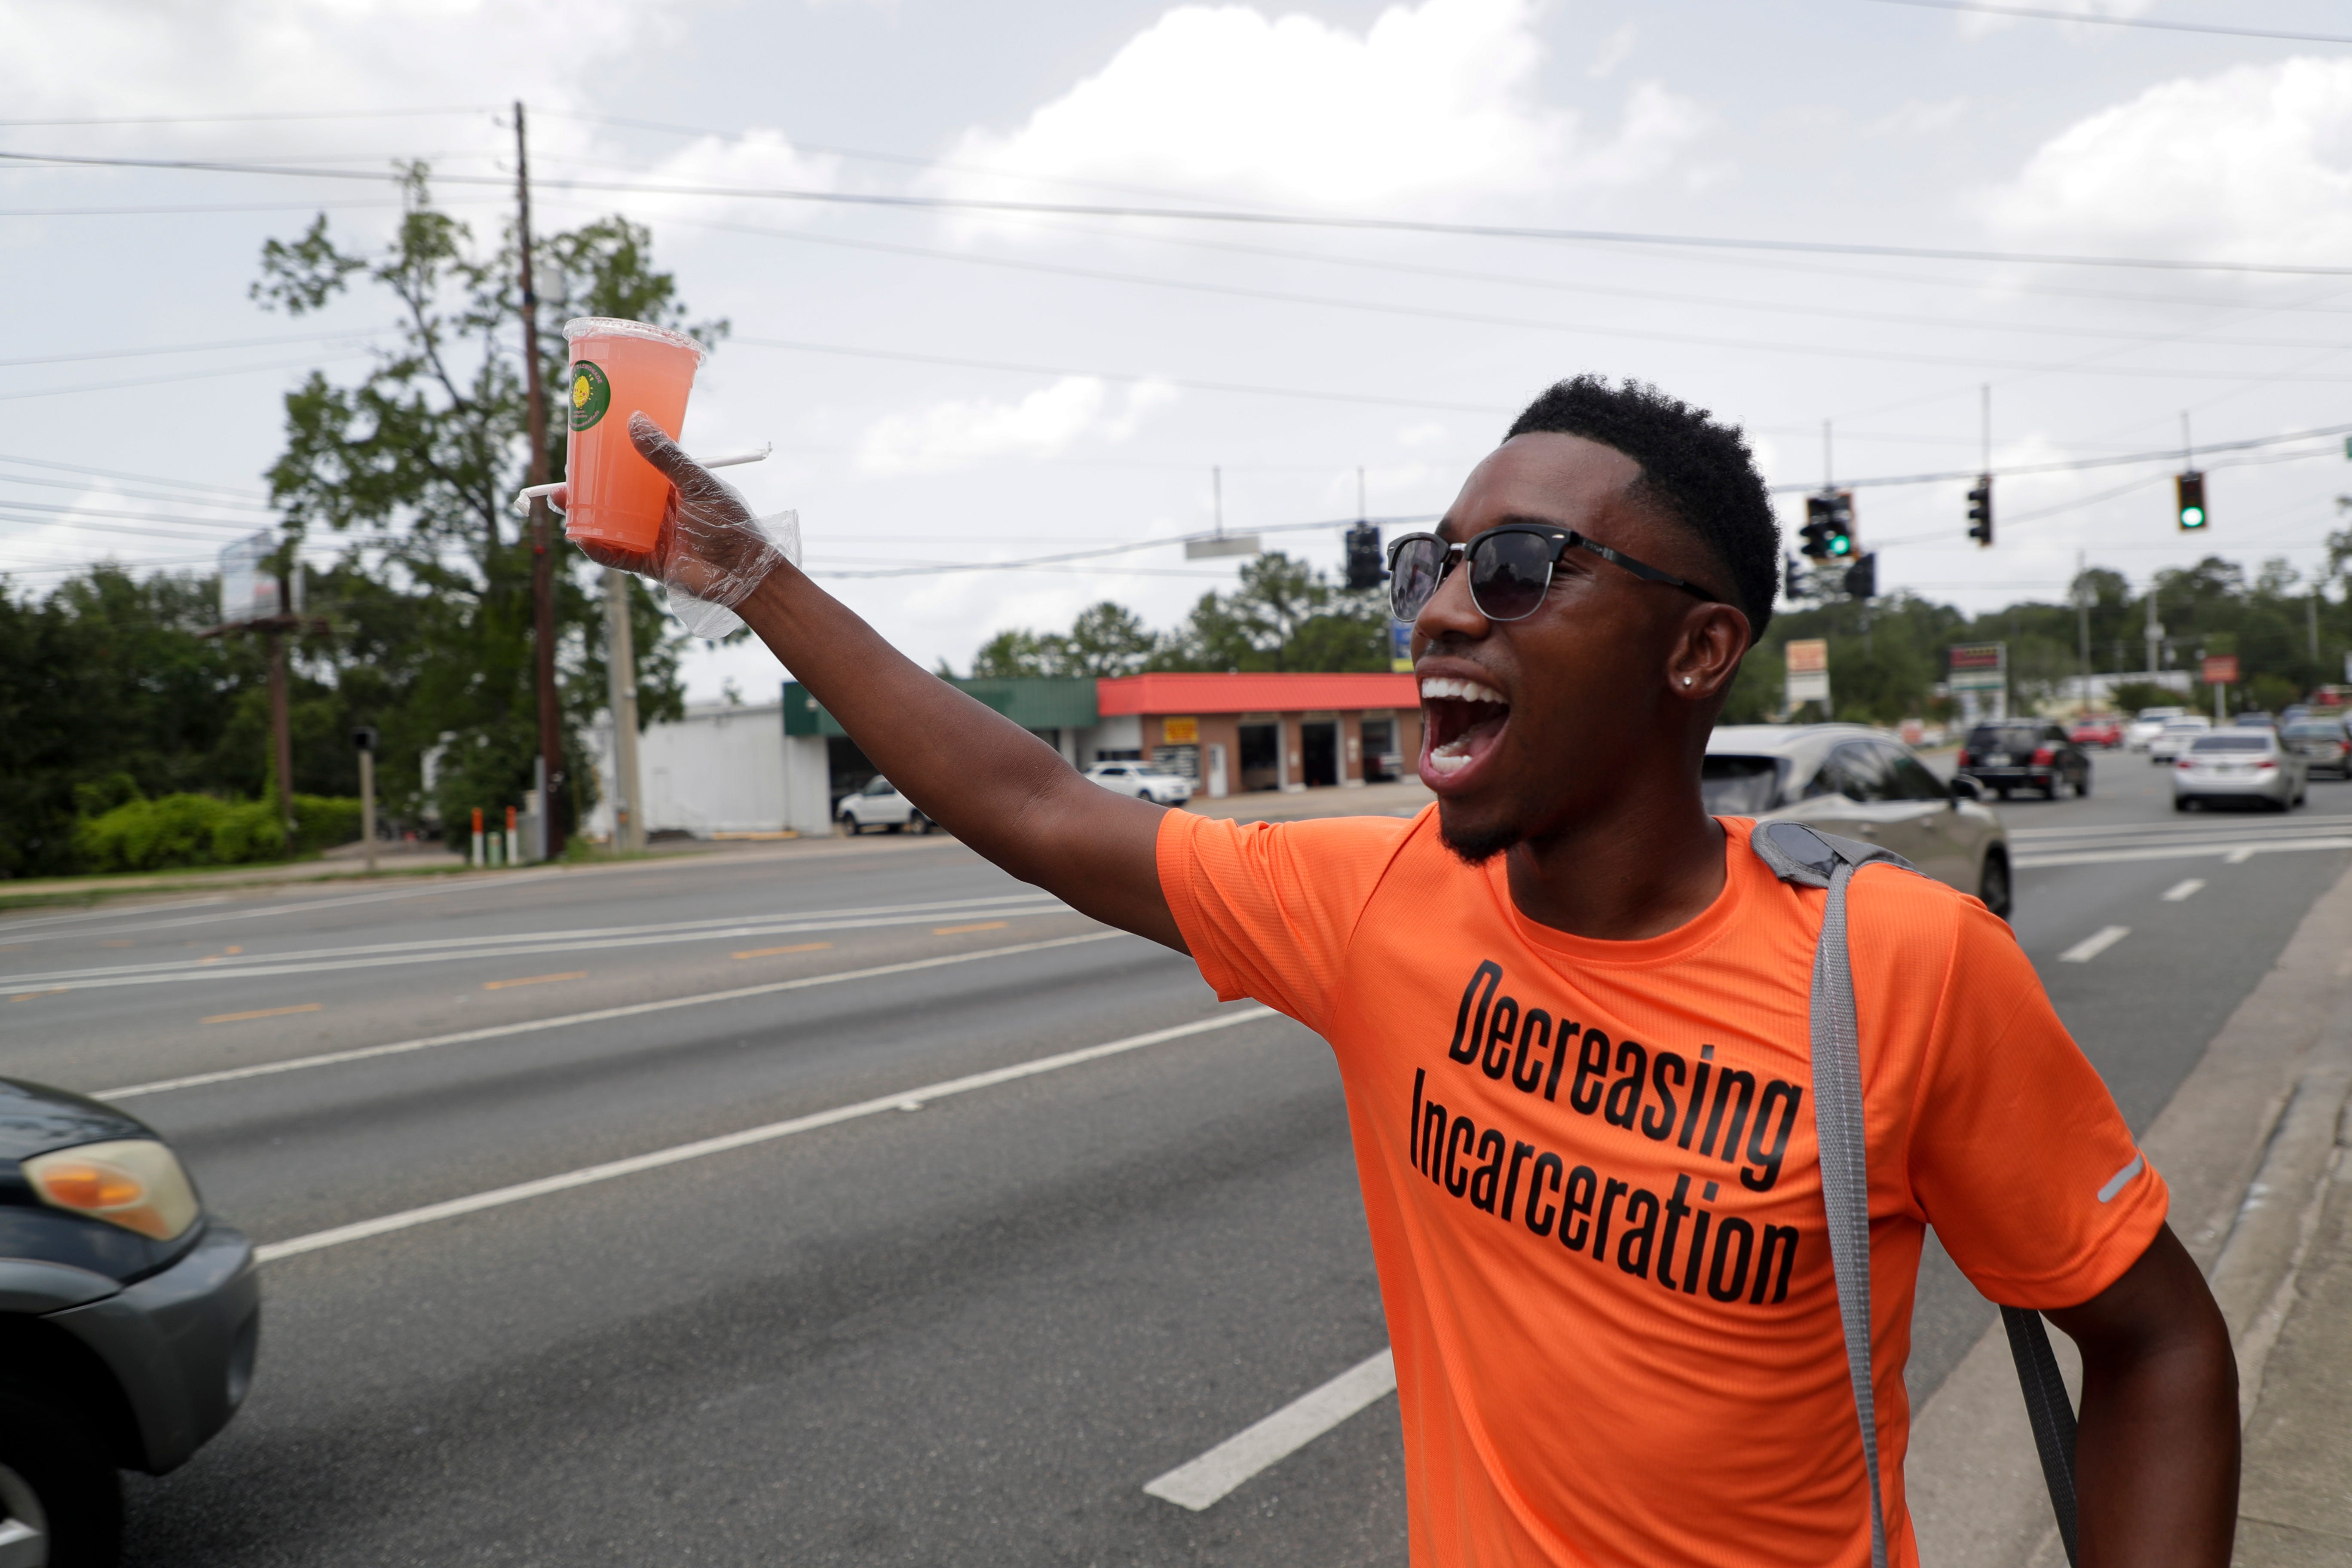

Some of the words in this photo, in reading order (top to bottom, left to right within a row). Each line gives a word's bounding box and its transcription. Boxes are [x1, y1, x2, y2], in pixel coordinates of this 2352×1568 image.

[579, 363, 603, 384] LEMONADE
[1410, 1068, 1799, 1305] Incarceration
[1449, 960, 1803, 1192] Decreasing
